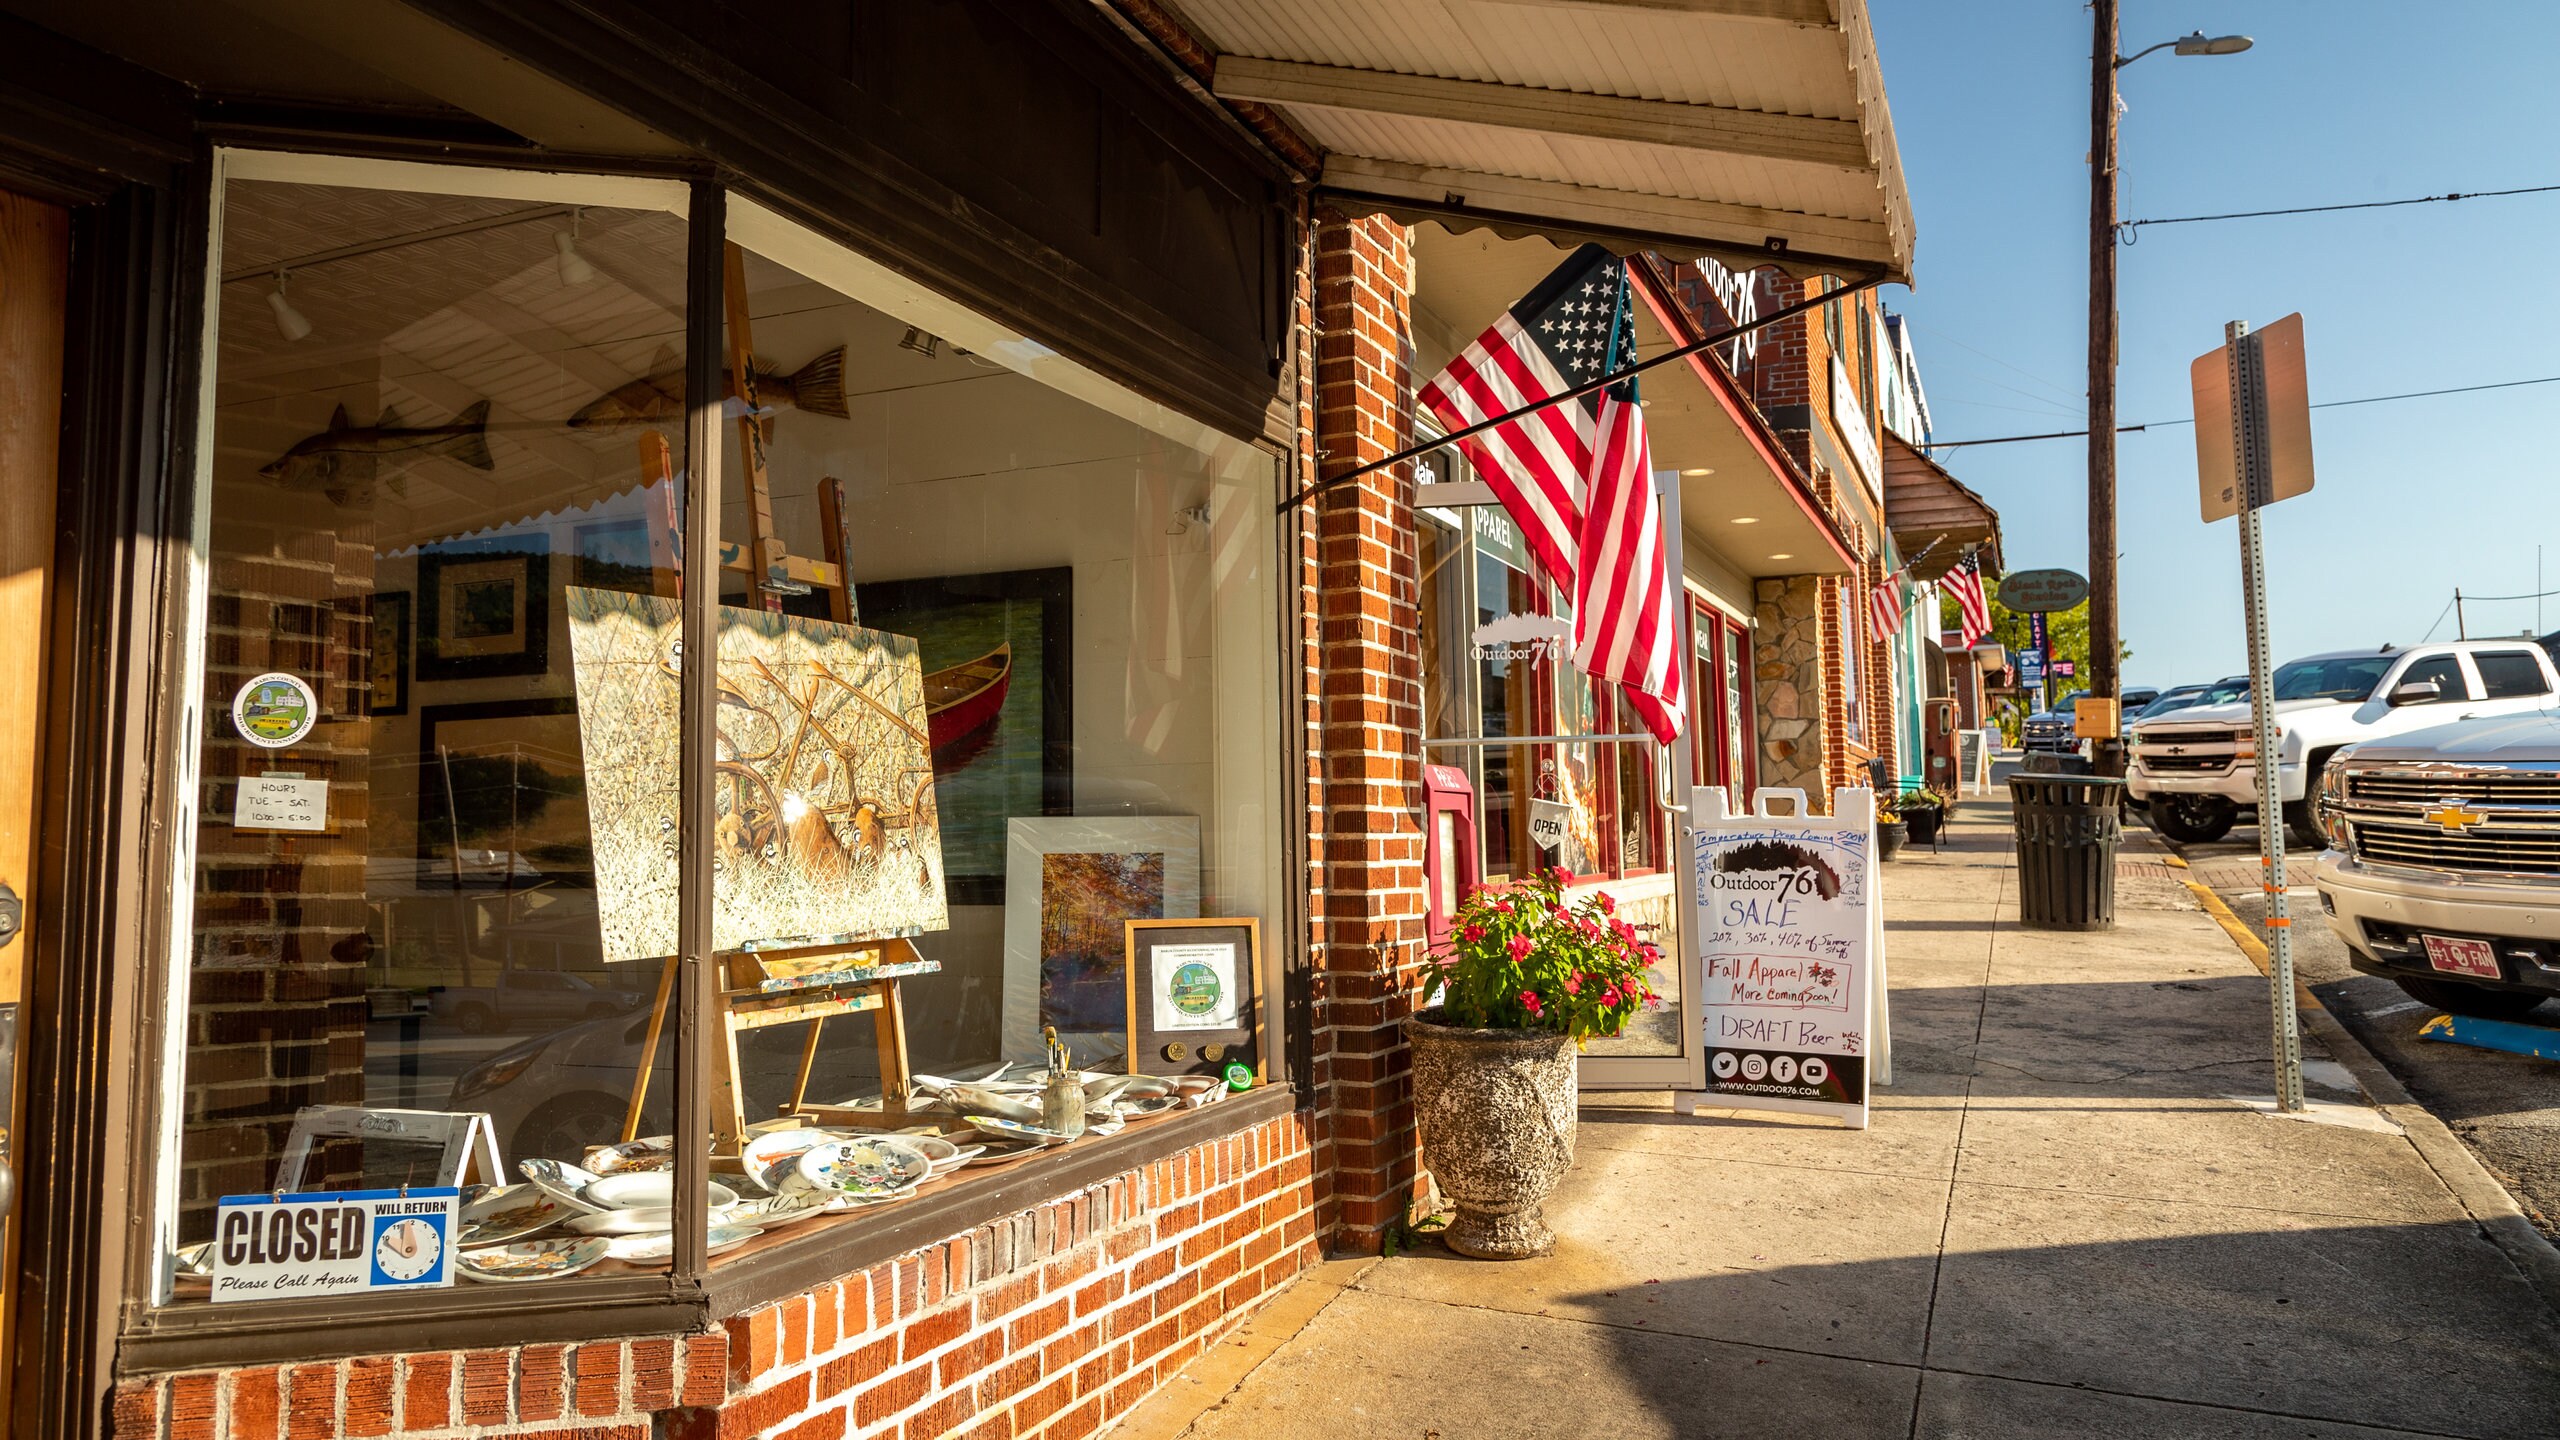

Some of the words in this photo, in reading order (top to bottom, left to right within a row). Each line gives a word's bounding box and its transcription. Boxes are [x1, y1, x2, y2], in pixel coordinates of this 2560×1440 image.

[261, 783, 296, 793] HOURS
[1534, 818, 1562, 836] OPEN
[1695, 831, 1765, 846] Temperature
[1769, 829, 1795, 841] Drop
[1800, 829, 1834, 851] Coming
[1723, 898, 1801, 928] SALE
[1778, 931, 1802, 948] 40%
[1805, 935, 1818, 952] of
[2430, 945, 2452, 962] #1
[2469, 950, 2495, 967] FAN
[1708, 957, 1741, 980] Fall
[1748, 957, 1803, 986] Apparel
[1731, 982, 1763, 1002] More
[1803, 986, 1838, 1004] Soon!
[1721, 1014, 1793, 1042] DRAFT
[1798, 1021, 1834, 1046] Beer
[1719, 1081, 1820, 1096] WWW.OUTDOOR76.COM
[375, 1203, 402, 1215] WILL
[404, 1201, 448, 1214] RETURN
[222, 1207, 366, 1266] CLOSED
[219, 1276, 269, 1291] Please
[273, 1273, 310, 1289] Call
[312, 1272, 359, 1289] Again
